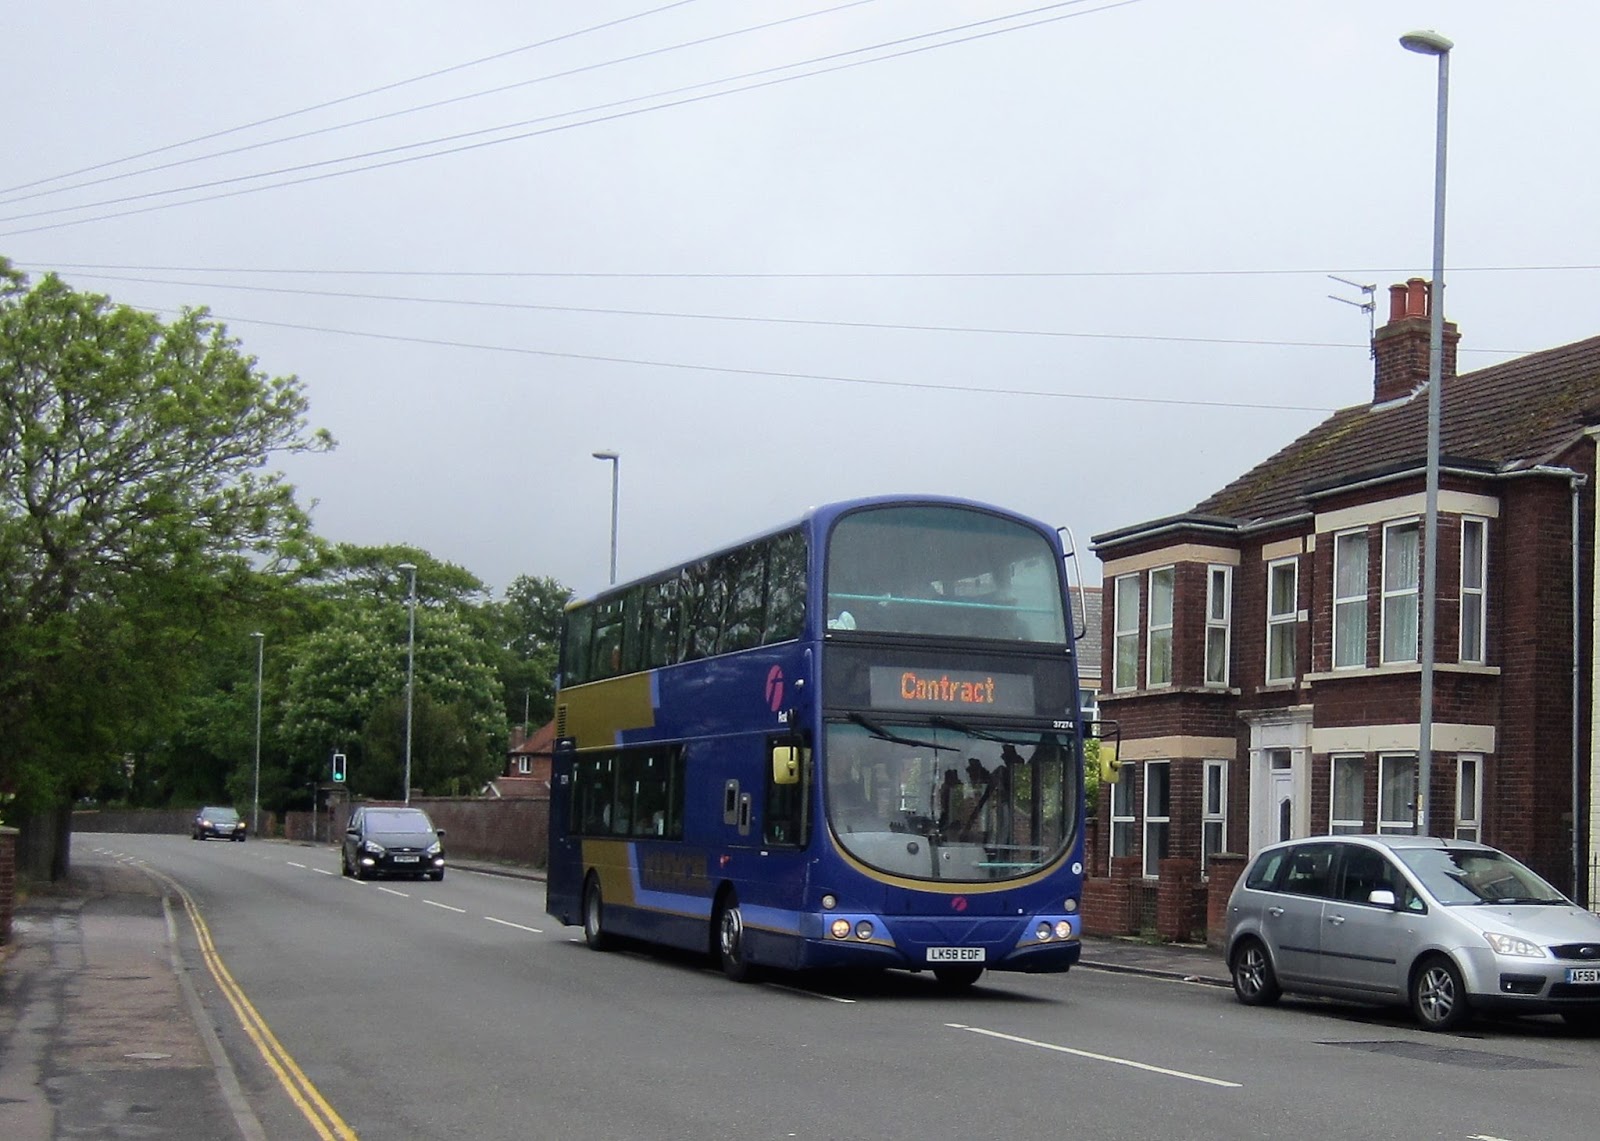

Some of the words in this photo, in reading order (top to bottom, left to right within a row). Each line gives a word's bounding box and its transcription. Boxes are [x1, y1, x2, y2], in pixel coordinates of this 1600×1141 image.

[901, 672, 994, 703] Contract
[1053, 720, 1073, 728] 37274
[931, 949, 958, 960] LK58
[1572, 970, 1595, 982] AF56
